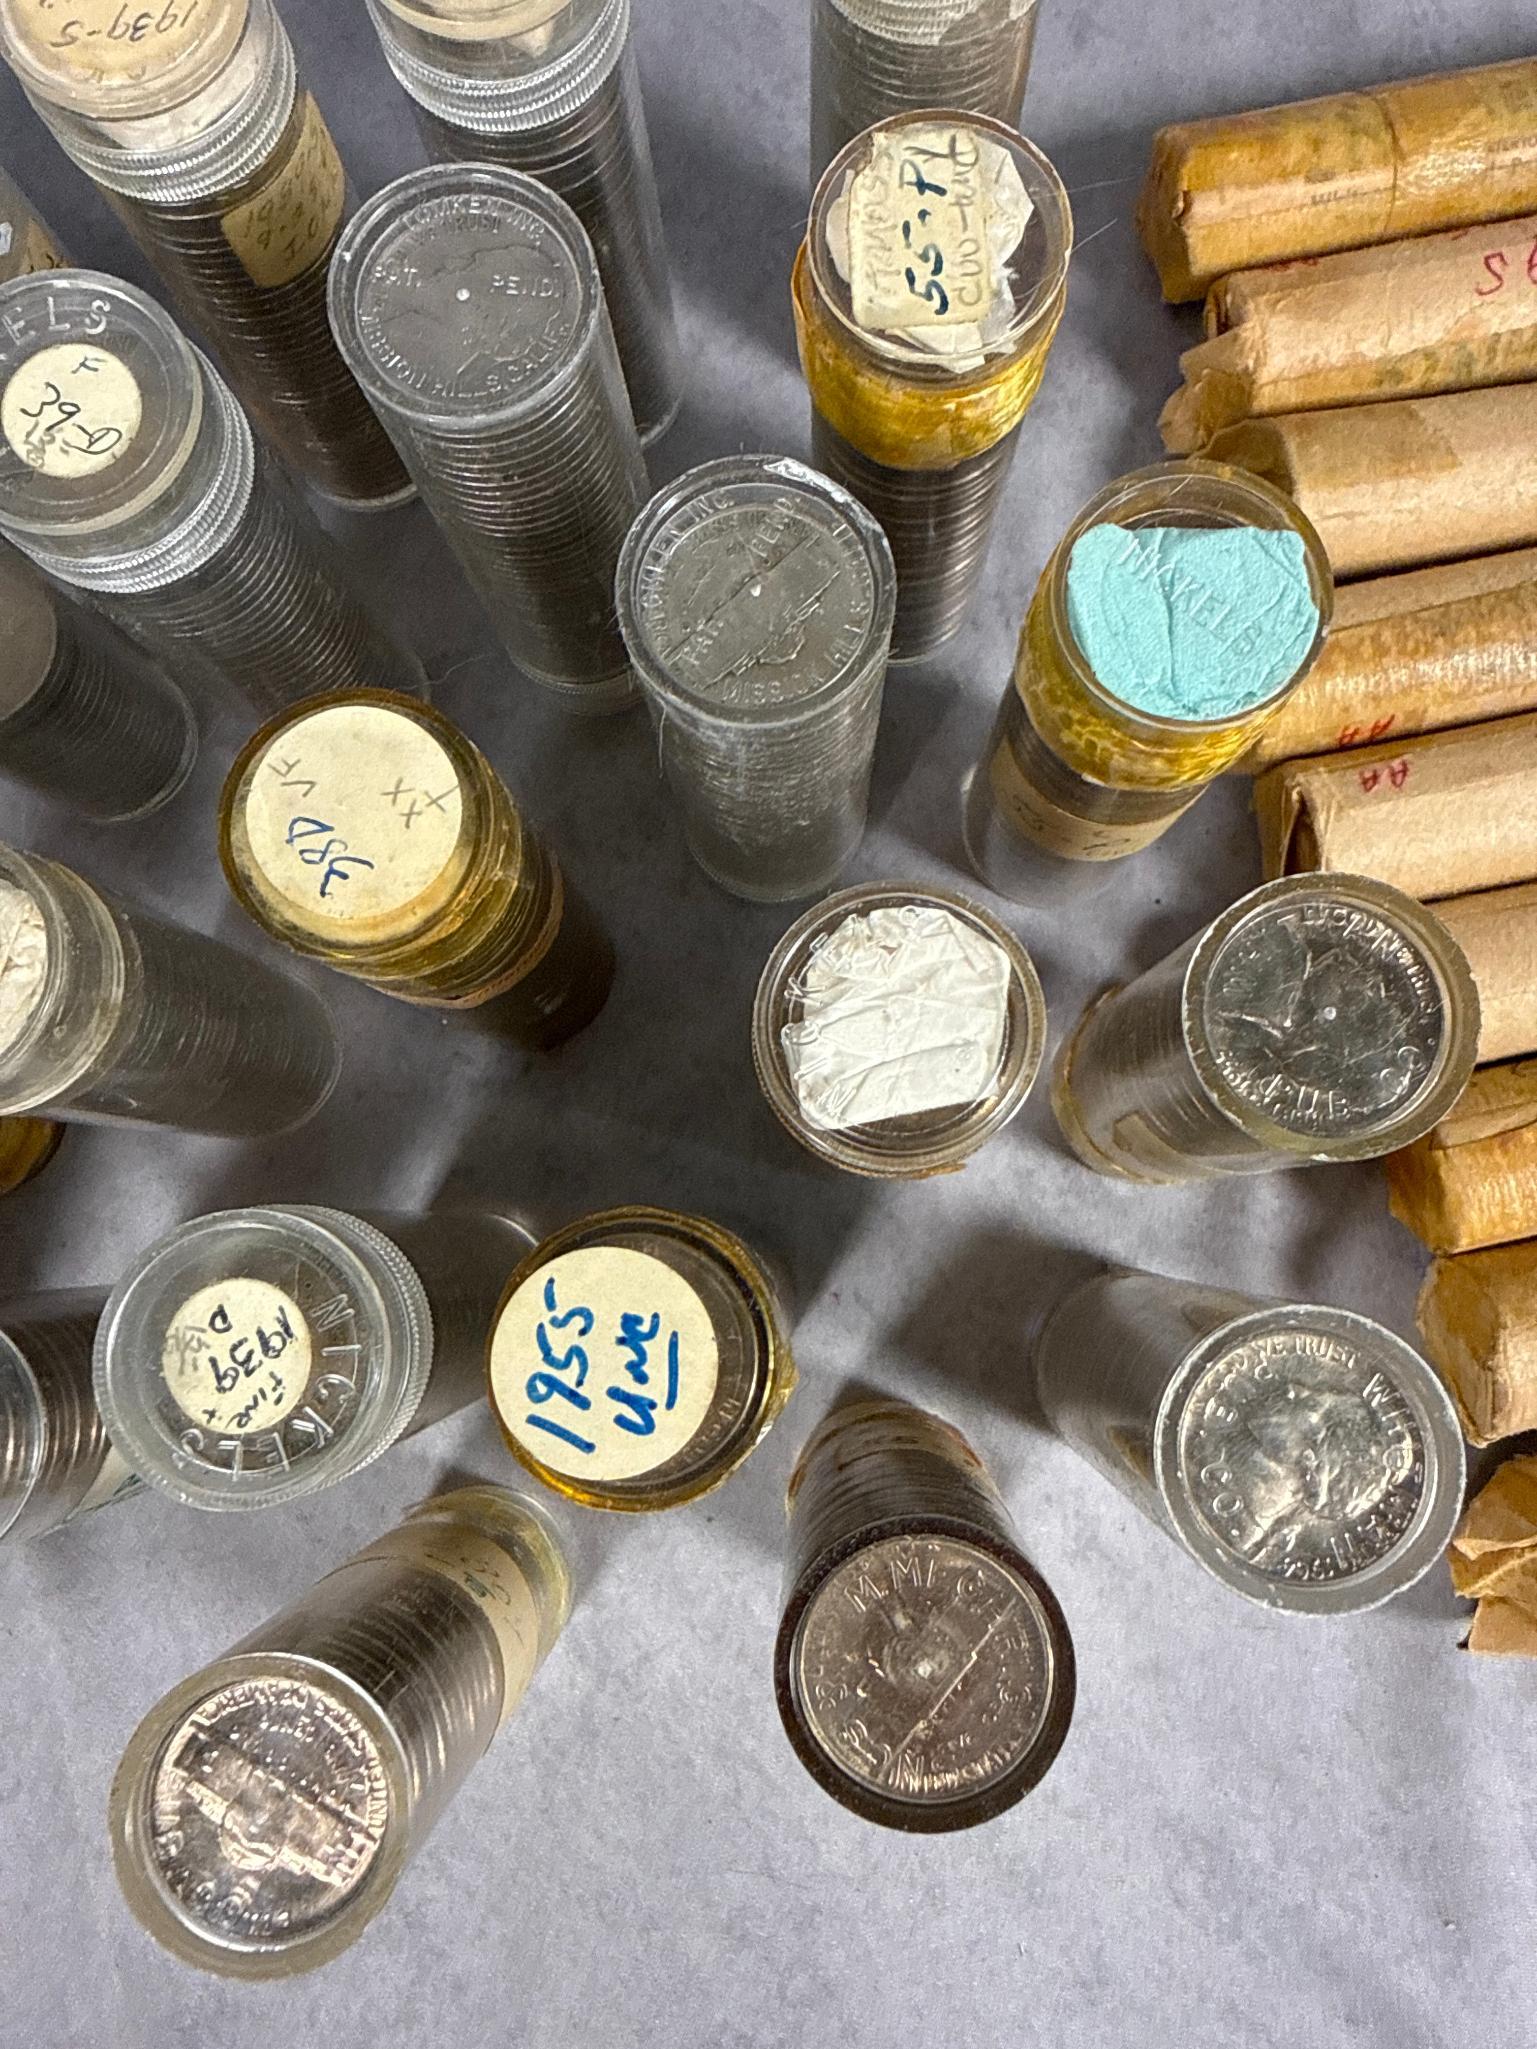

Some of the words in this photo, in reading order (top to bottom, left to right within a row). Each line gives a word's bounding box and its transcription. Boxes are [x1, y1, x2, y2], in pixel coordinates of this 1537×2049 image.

[172, 1293, 363, 1481] NICKELS
[209, 1304, 296, 1396] 1939
[525, 1276, 597, 1455] 1955
